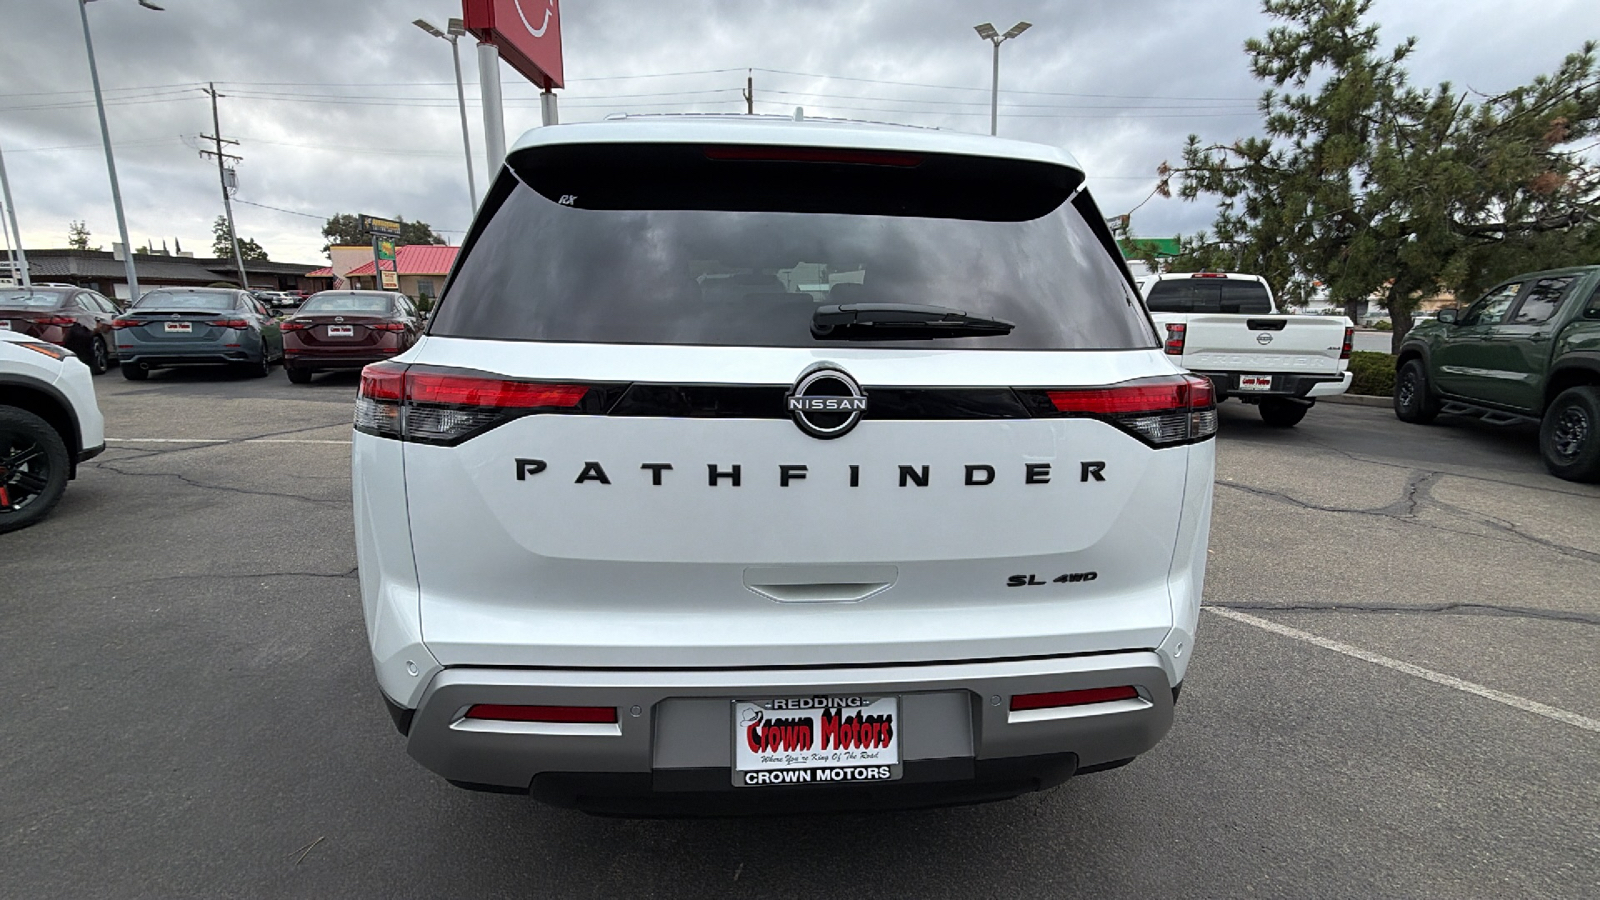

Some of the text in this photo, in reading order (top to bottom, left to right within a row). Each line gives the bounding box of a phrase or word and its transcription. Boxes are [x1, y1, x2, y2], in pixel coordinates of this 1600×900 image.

[789, 399, 866, 409] NISSAN
[514, 457, 1106, 488] PATHFINDER
[1006, 571, 1098, 588] SL 4WD
[746, 707, 894, 754] Crown Motors
[760, 751, 879, 766] Where You're King Of The Road
[745, 766, 891, 785] CROWN MOTORS
